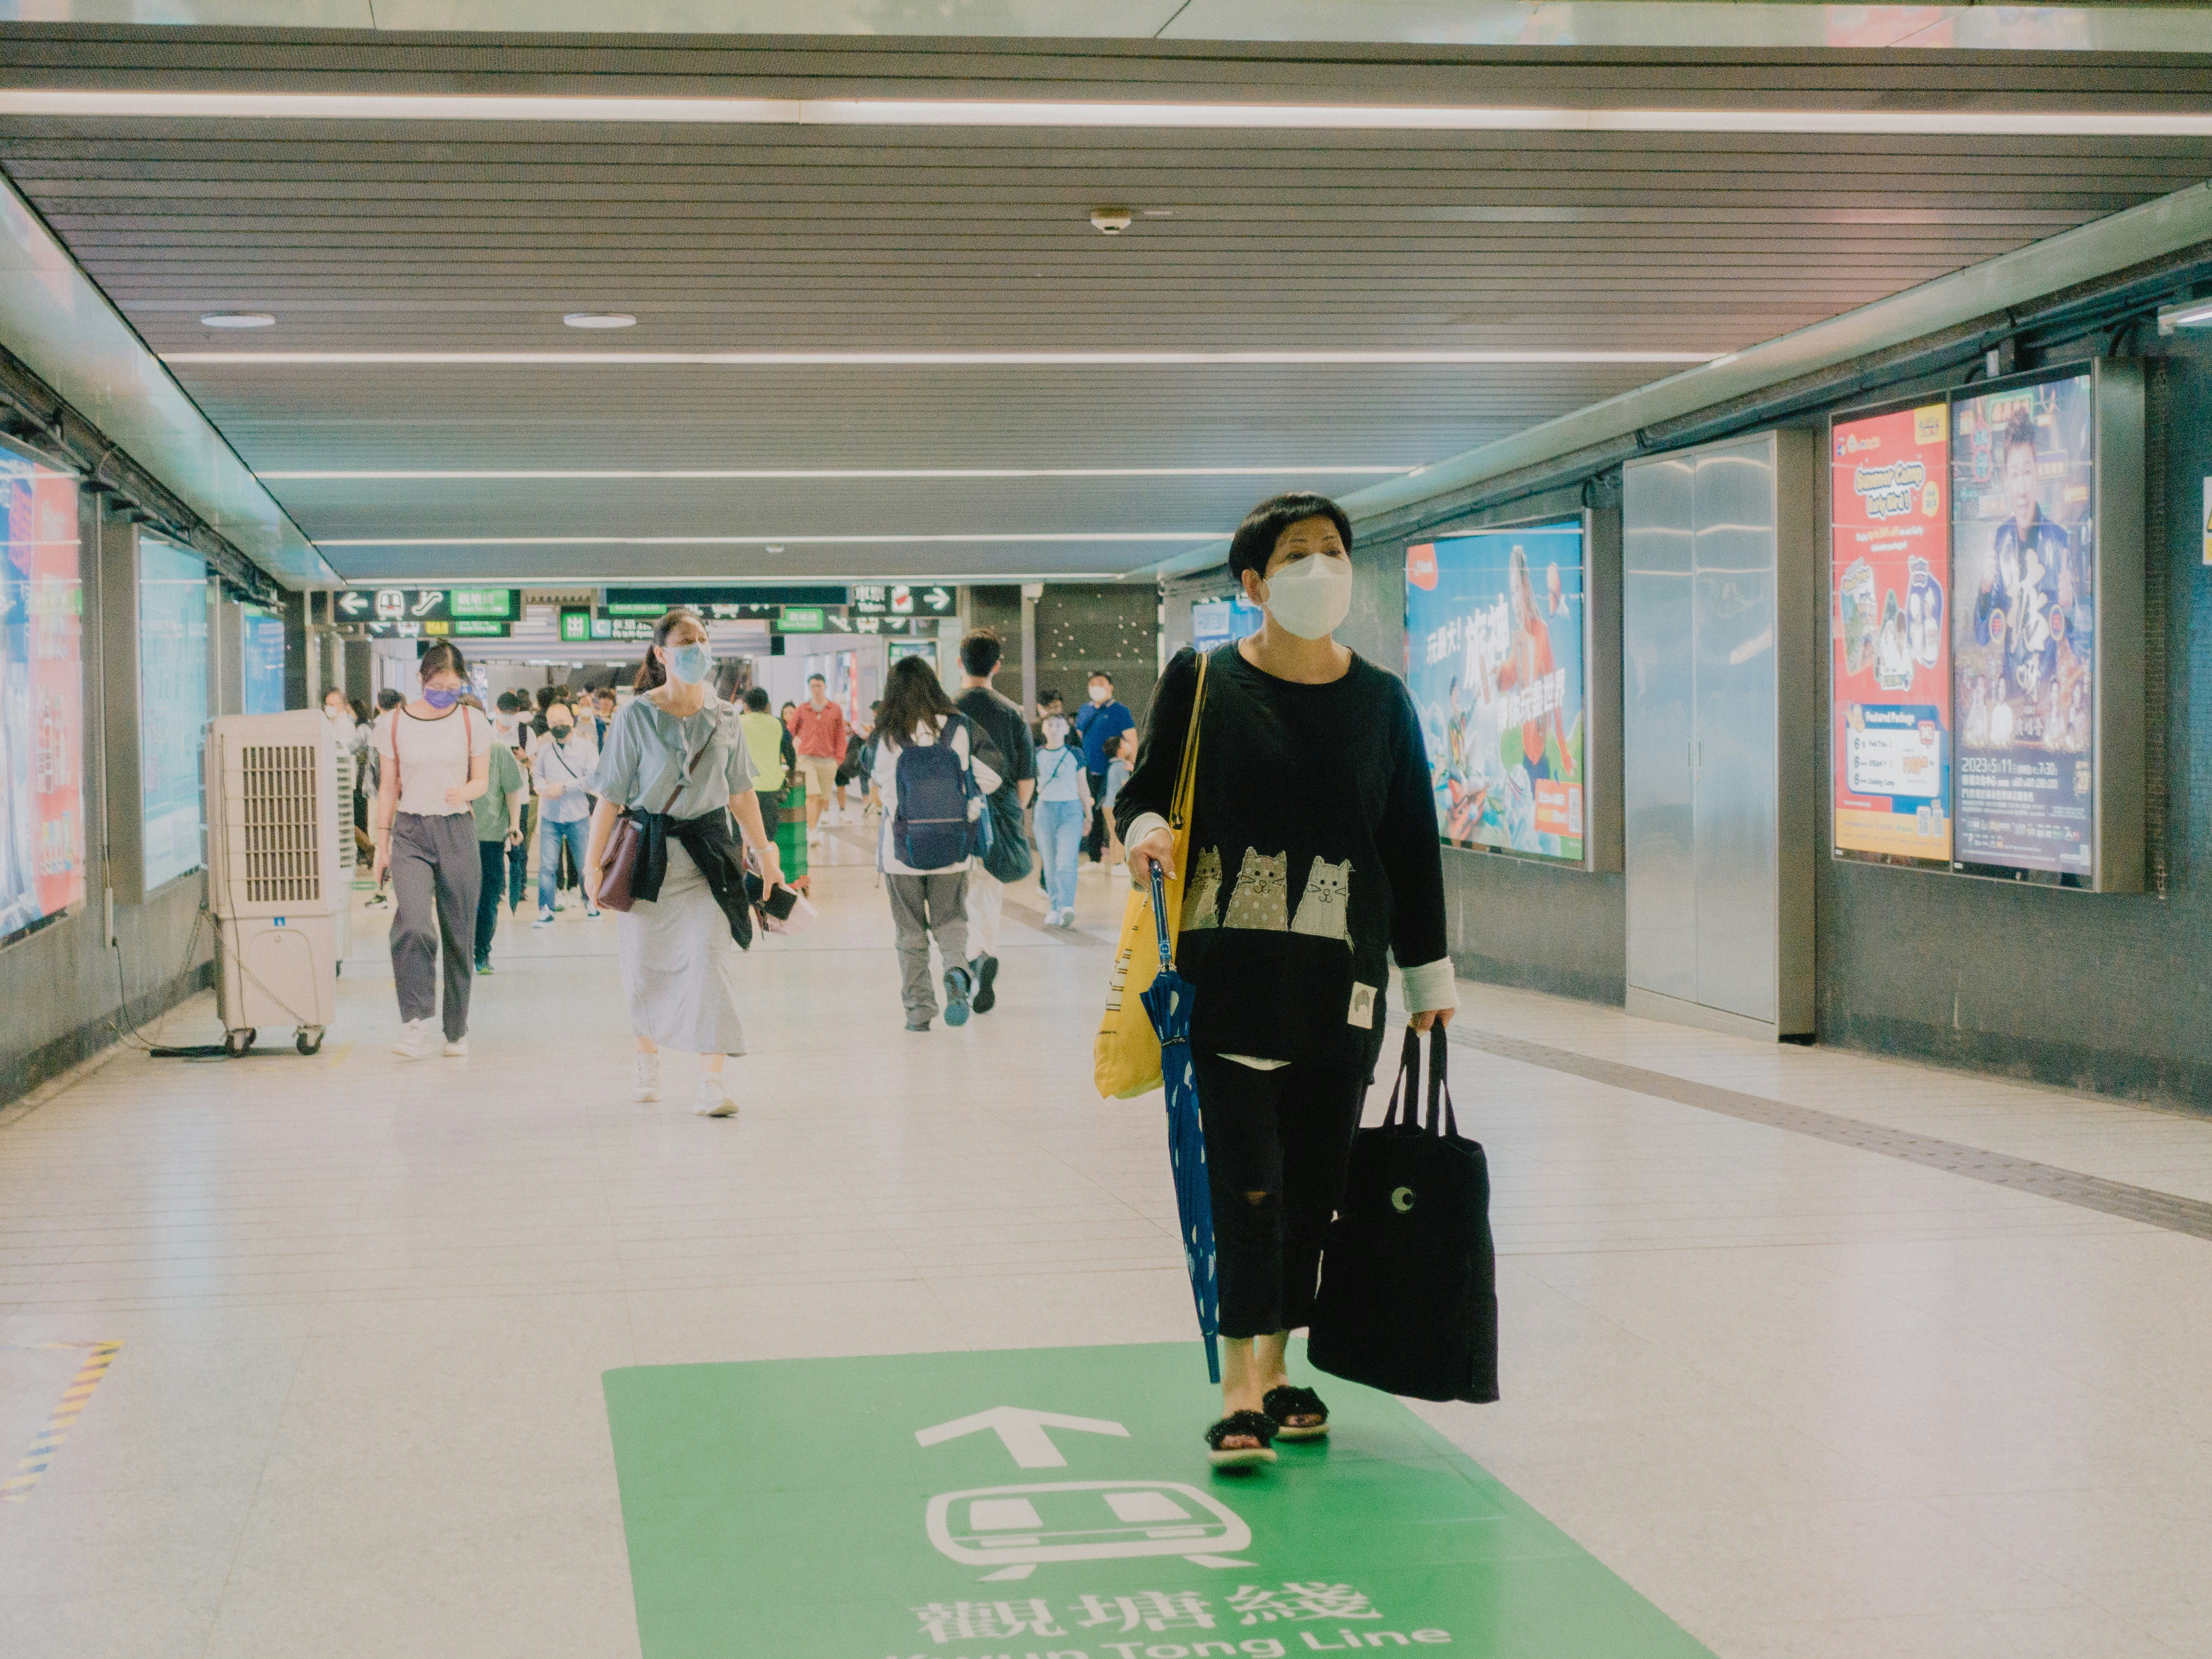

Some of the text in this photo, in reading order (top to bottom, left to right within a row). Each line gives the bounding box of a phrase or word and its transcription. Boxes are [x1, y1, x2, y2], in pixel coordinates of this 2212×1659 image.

[597, 620, 605, 634] C
[1100, 1637, 1287, 1659] Tong
[1299, 1628, 1453, 1651] Line
